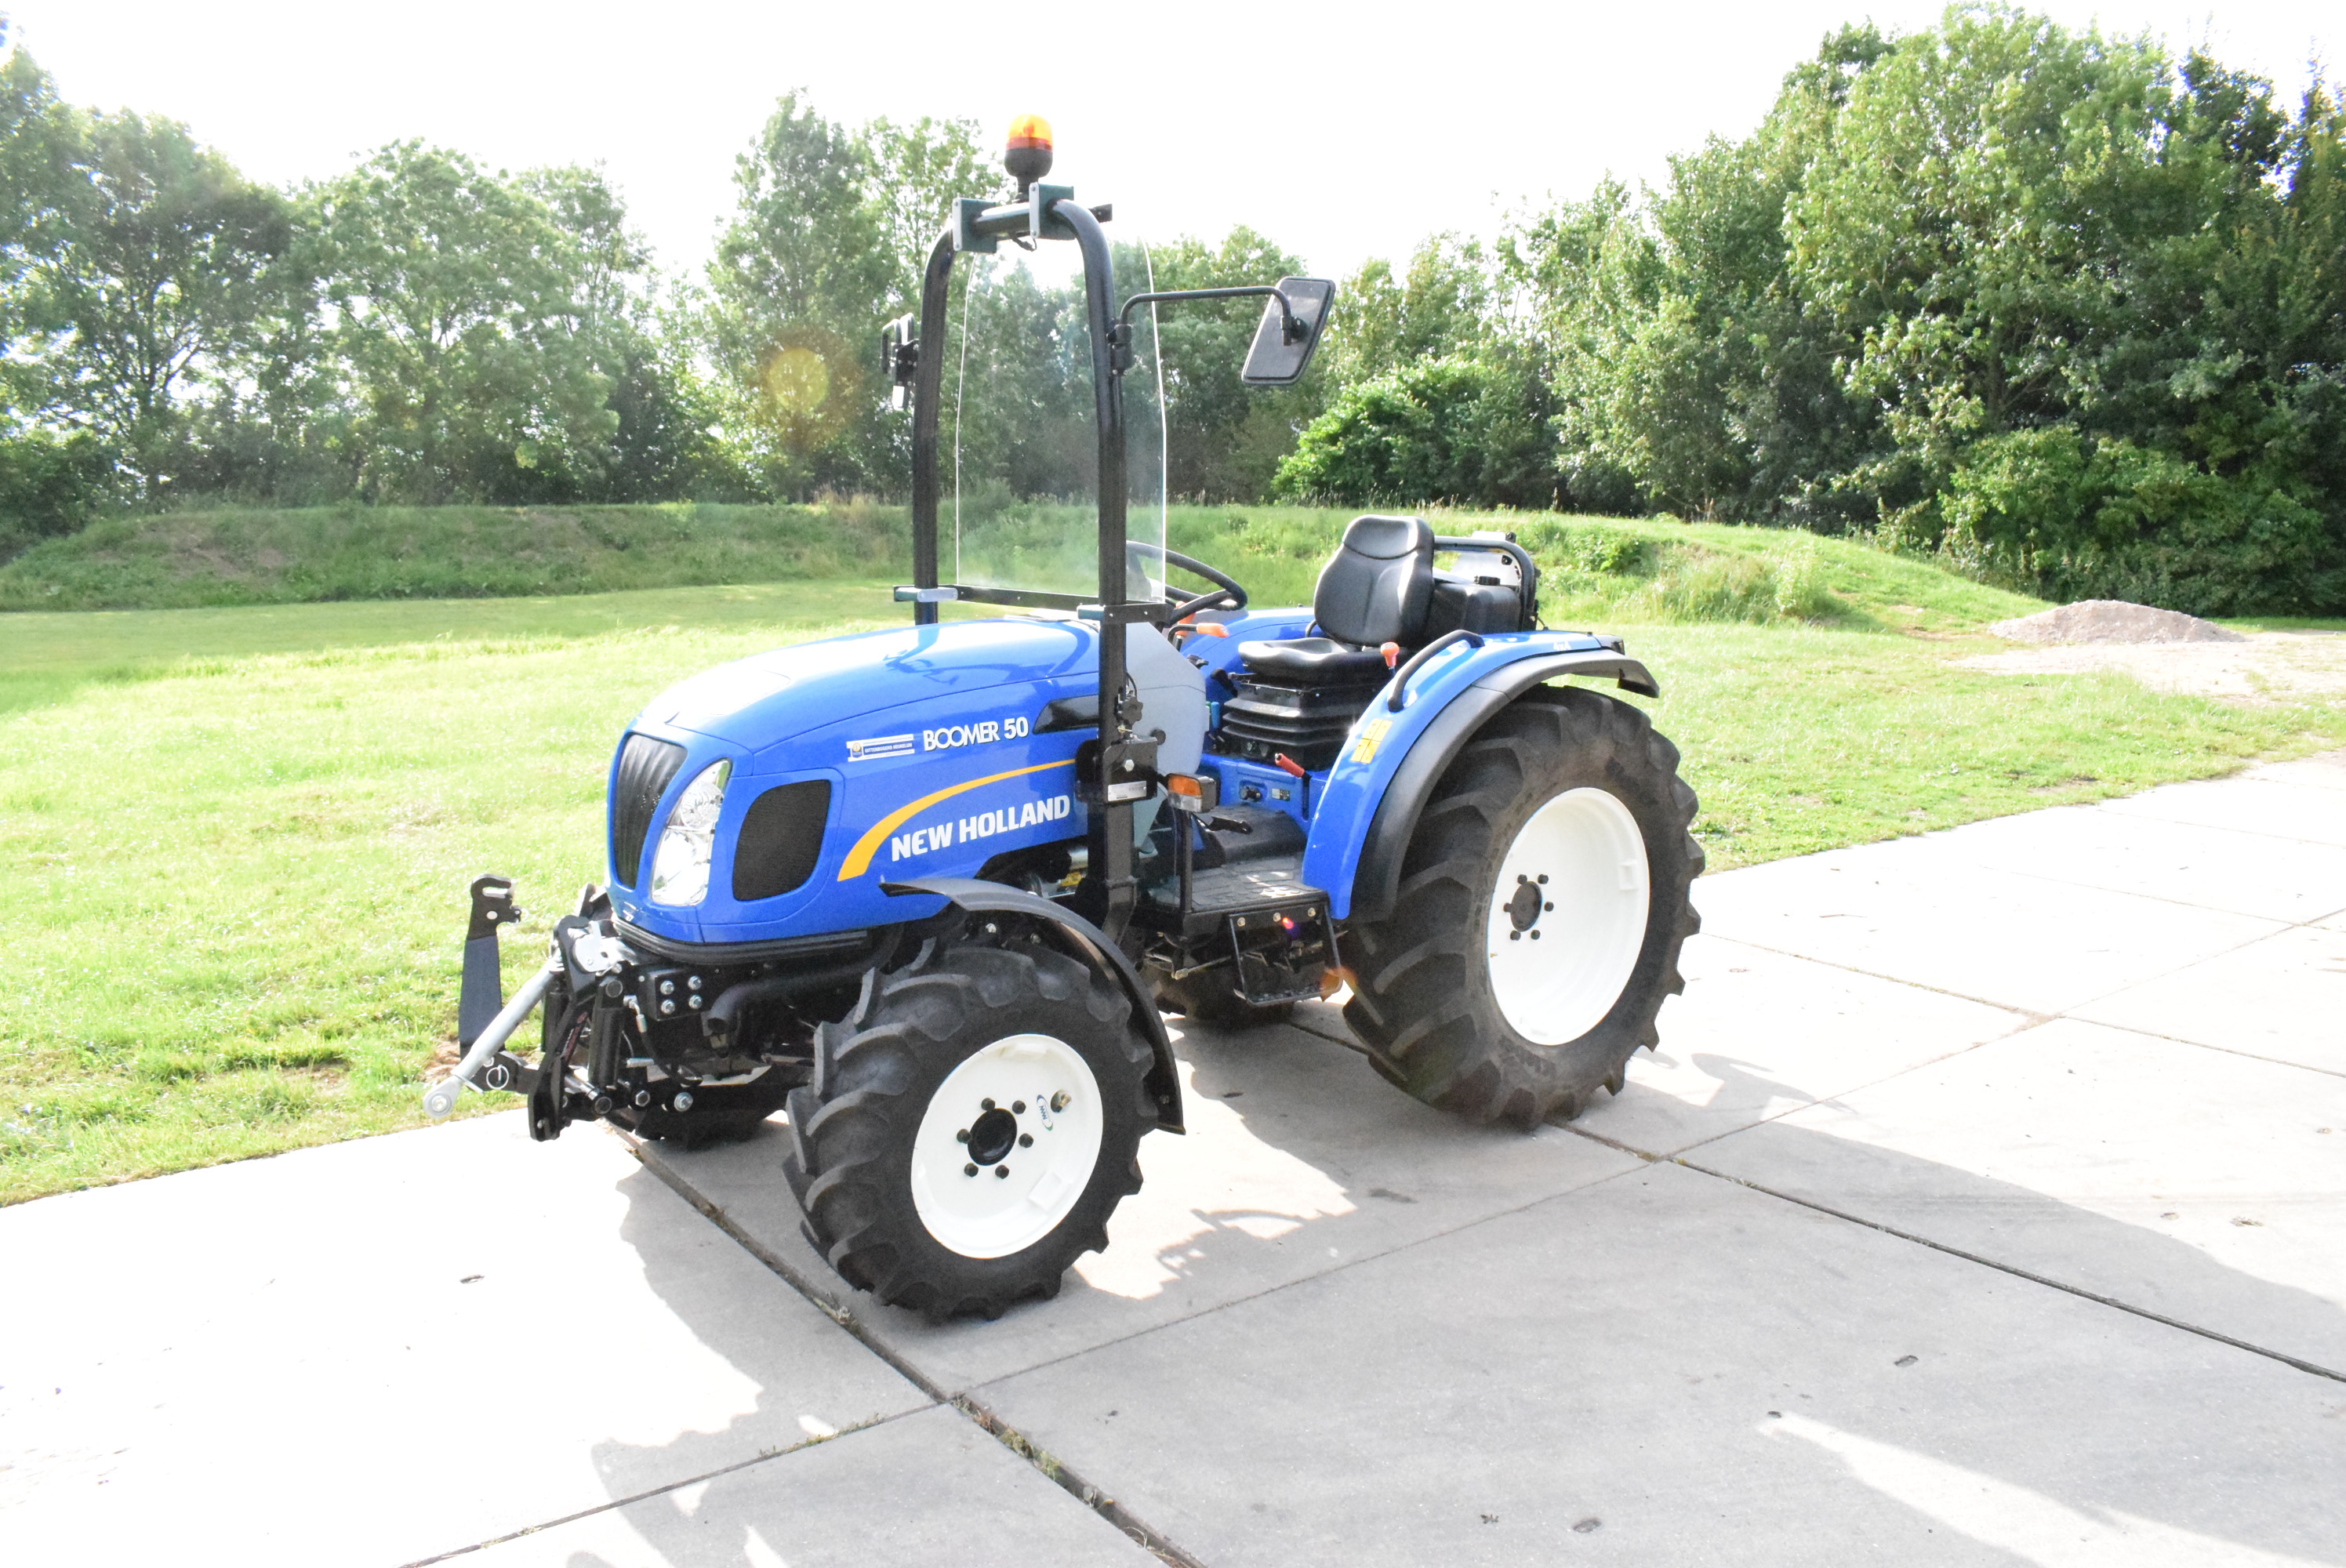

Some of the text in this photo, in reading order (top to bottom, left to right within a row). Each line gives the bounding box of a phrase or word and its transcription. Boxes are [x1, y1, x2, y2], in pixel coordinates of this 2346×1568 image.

[923, 717, 1029, 752] BOOMER 50
[892, 795, 1070, 862] NEW HOLLAND
